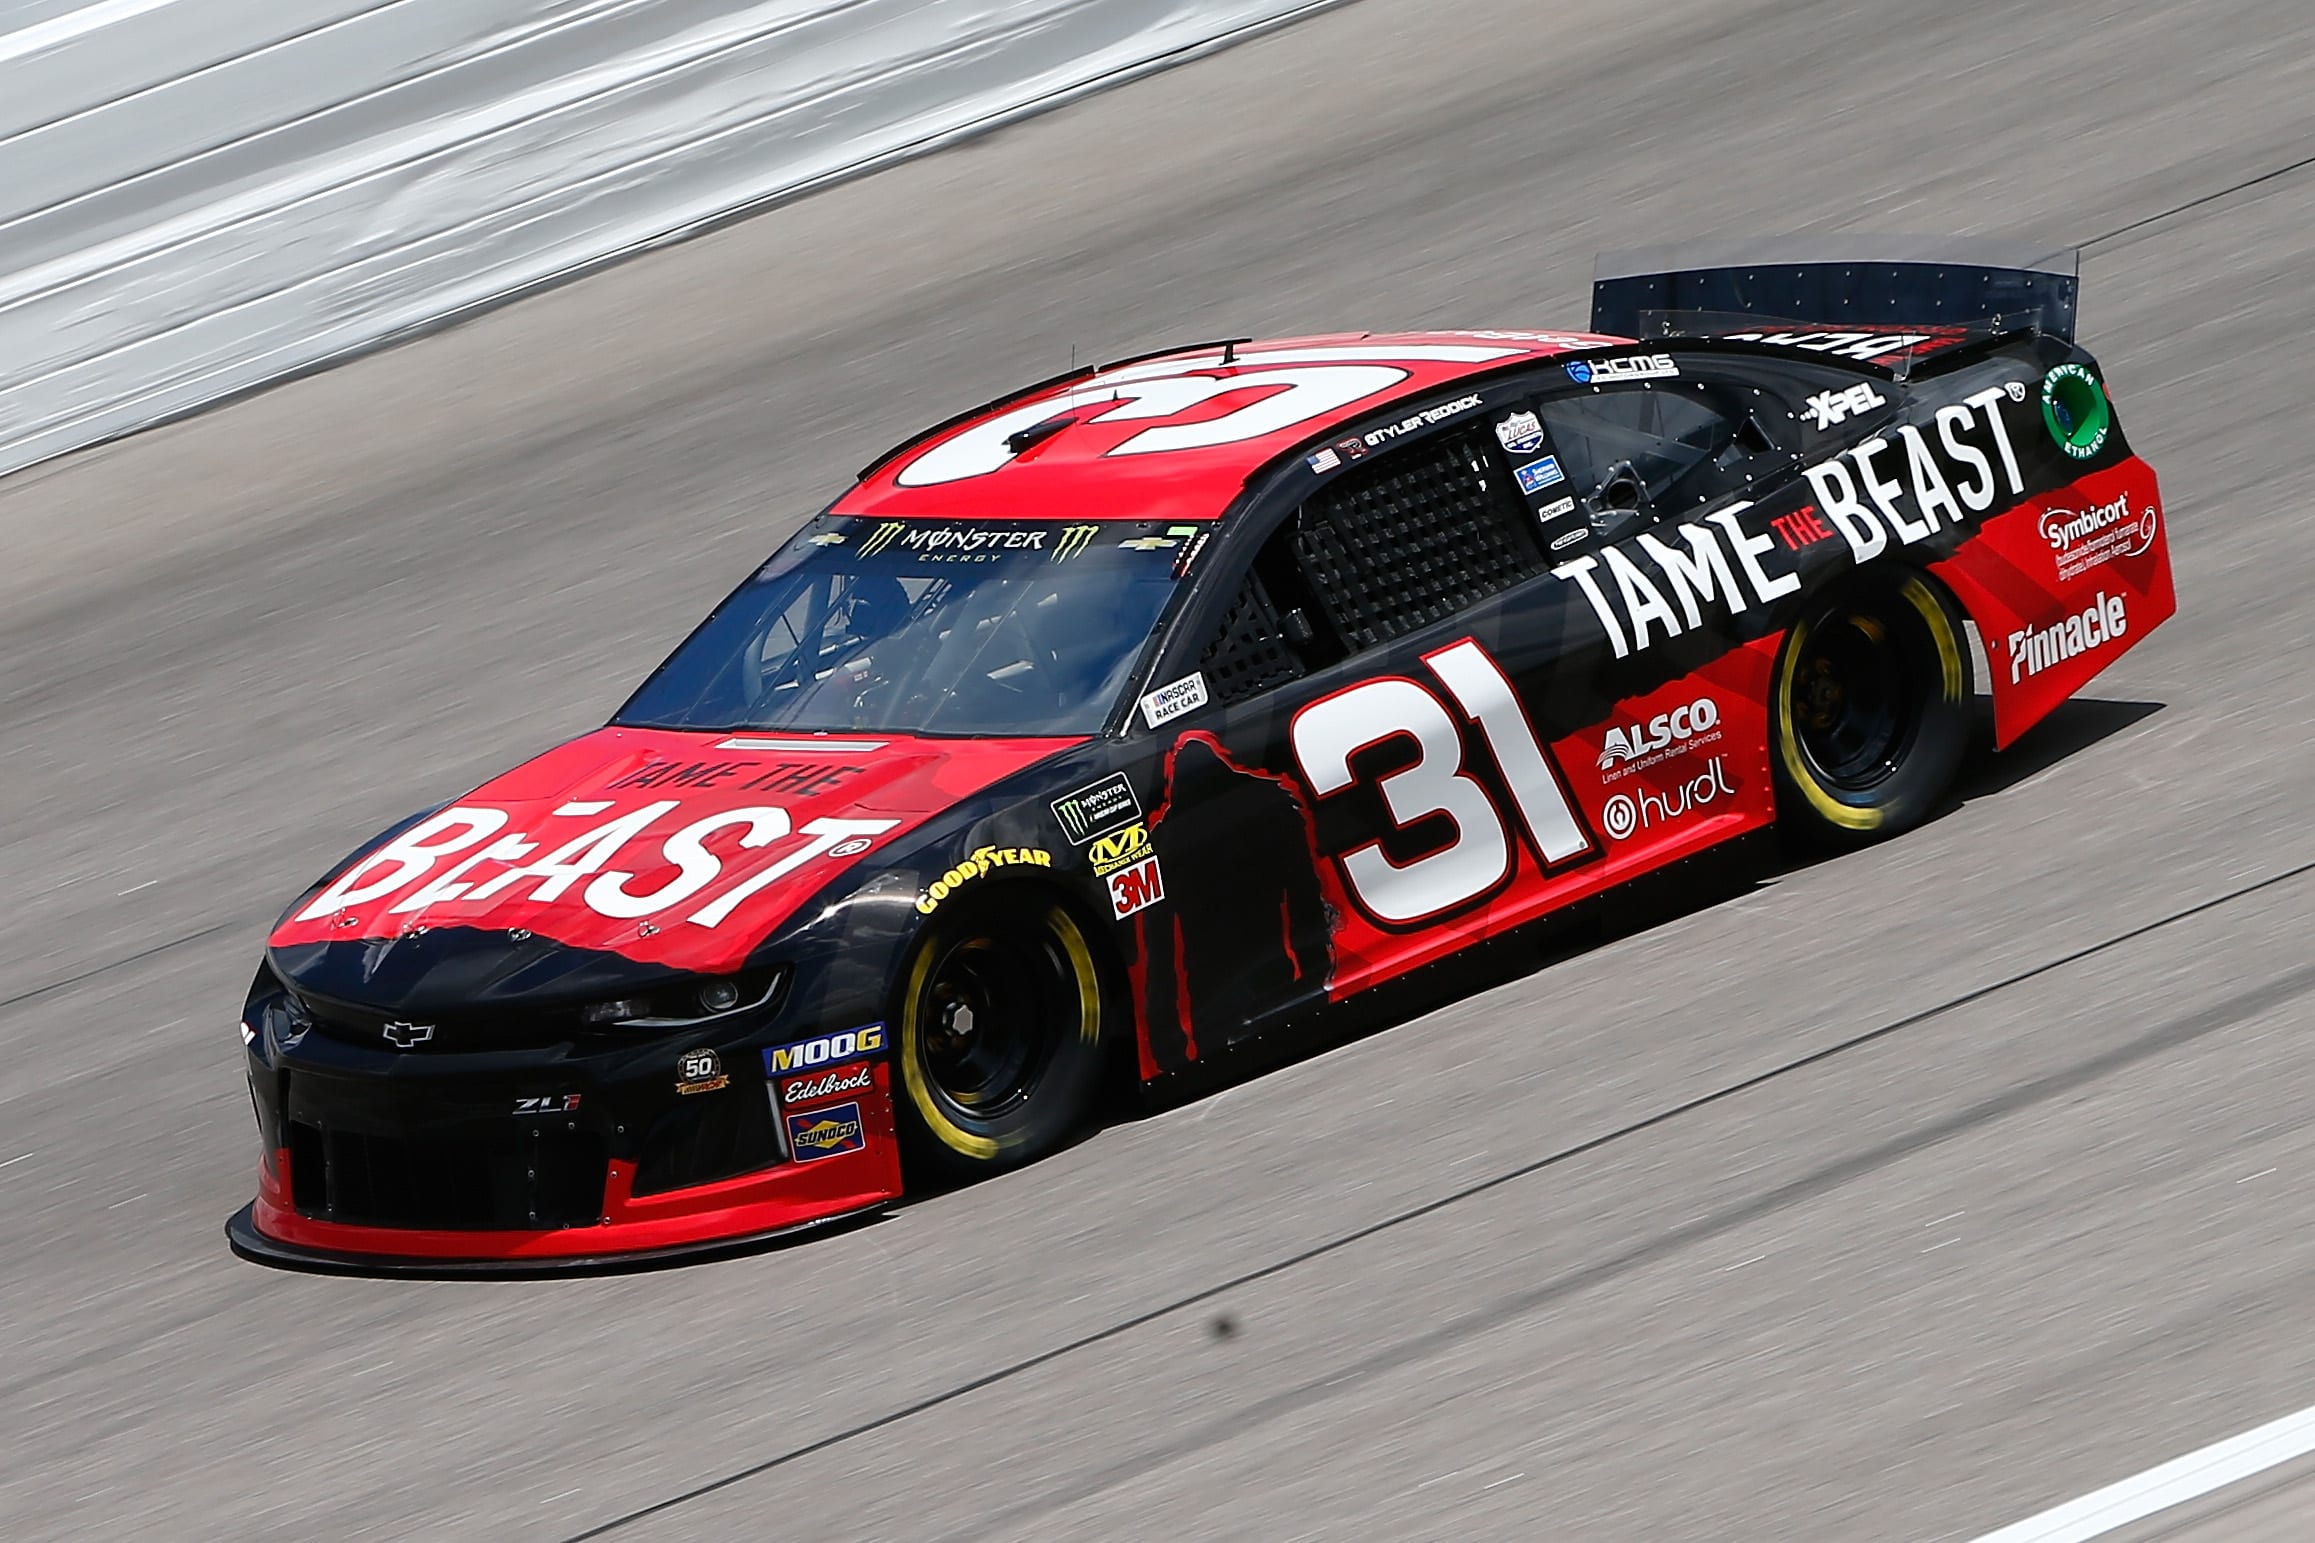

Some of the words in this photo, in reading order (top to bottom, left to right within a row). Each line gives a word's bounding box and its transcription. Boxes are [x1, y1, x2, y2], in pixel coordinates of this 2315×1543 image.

[1588, 354, 1675, 374] KCMG
[2041, 364, 2095, 405] AMERICAN
[1805, 382, 1887, 431] XPEL
[2063, 427, 2108, 458] ETHANOL
[2047, 494, 2130, 551] Symbicort
[918, 553, 1002, 563] ENERGY
[1550, 501, 1801, 659] TAME
[1770, 505, 1834, 551] THE
[2008, 591, 2127, 685] Pinnacle
[1155, 702, 1180, 720] RACE
[1181, 693, 1200, 708] CAR
[1159, 680, 1197, 703] NASCAR
[1597, 698, 1718, 770] ALSCO
[606, 762, 761, 790] TAME
[739, 763, 865, 797] THE
[1291, 637, 1592, 924] 31
[1637, 756, 1735, 828] hurdl
[1111, 861, 1162, 914] 3M
[685, 1057, 712, 1078] 50
[771, 1025, 882, 1073] MOOG
[512, 1094, 582, 1115] ZL1
[784, 1067, 872, 1104] Edelbrock
[796, 1120, 857, 1148] SUNOCO
